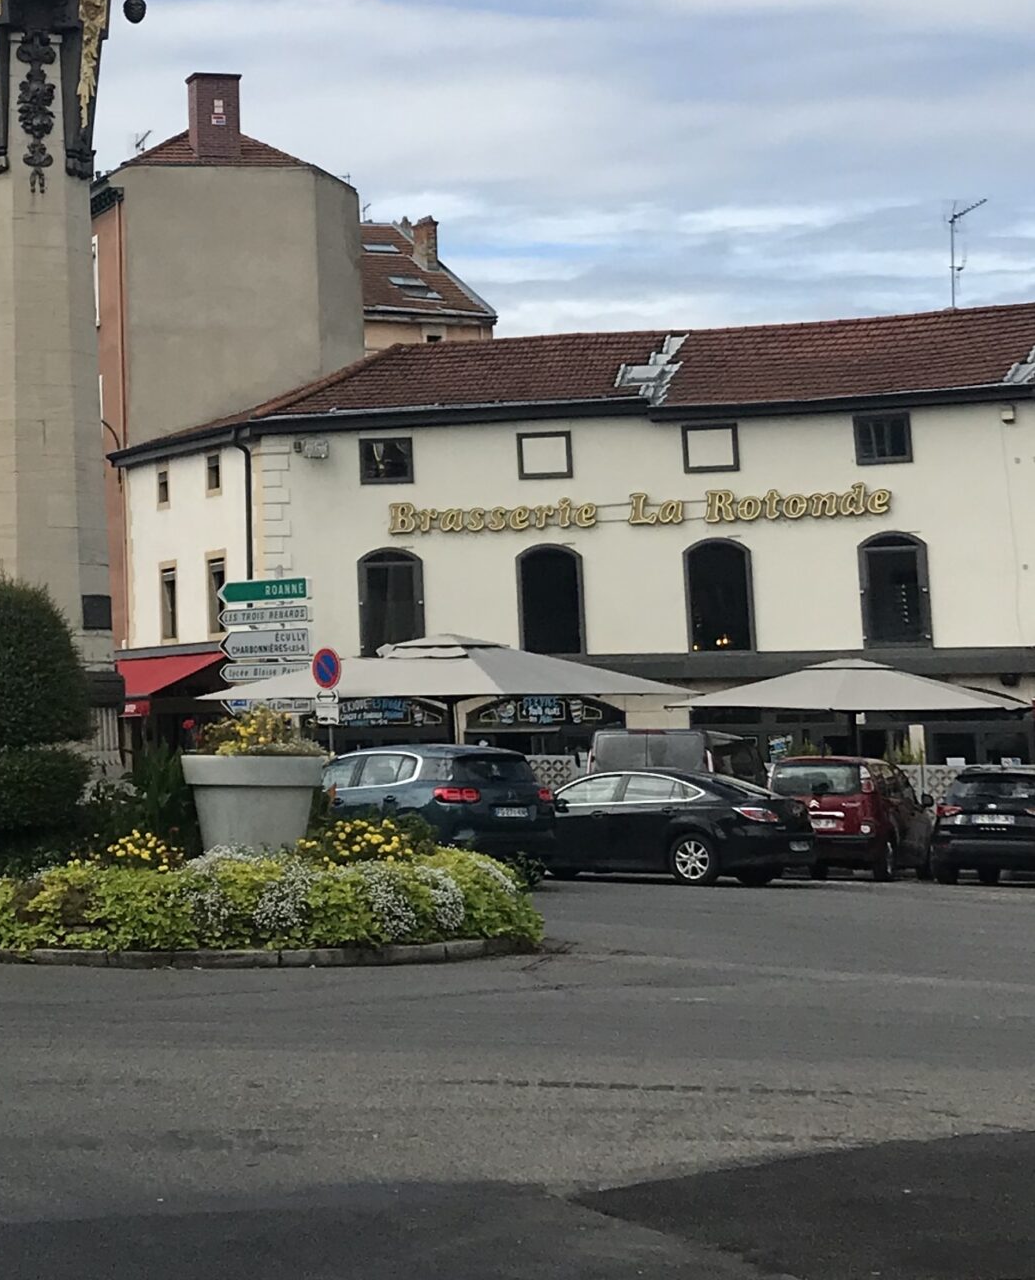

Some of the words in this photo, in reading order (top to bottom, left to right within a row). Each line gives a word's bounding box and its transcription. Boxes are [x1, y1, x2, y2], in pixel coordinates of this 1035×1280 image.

[389, 497, 598, 534] Brasserie
[628, 492, 683, 526] La
[705, 483, 892, 524] Rotonde
[265, 583, 304, 596] ROANNE
[242, 611, 264, 621] TROIS
[269, 609, 305, 620] RENARDS
[275, 631, 306, 642] ÉCULLY
